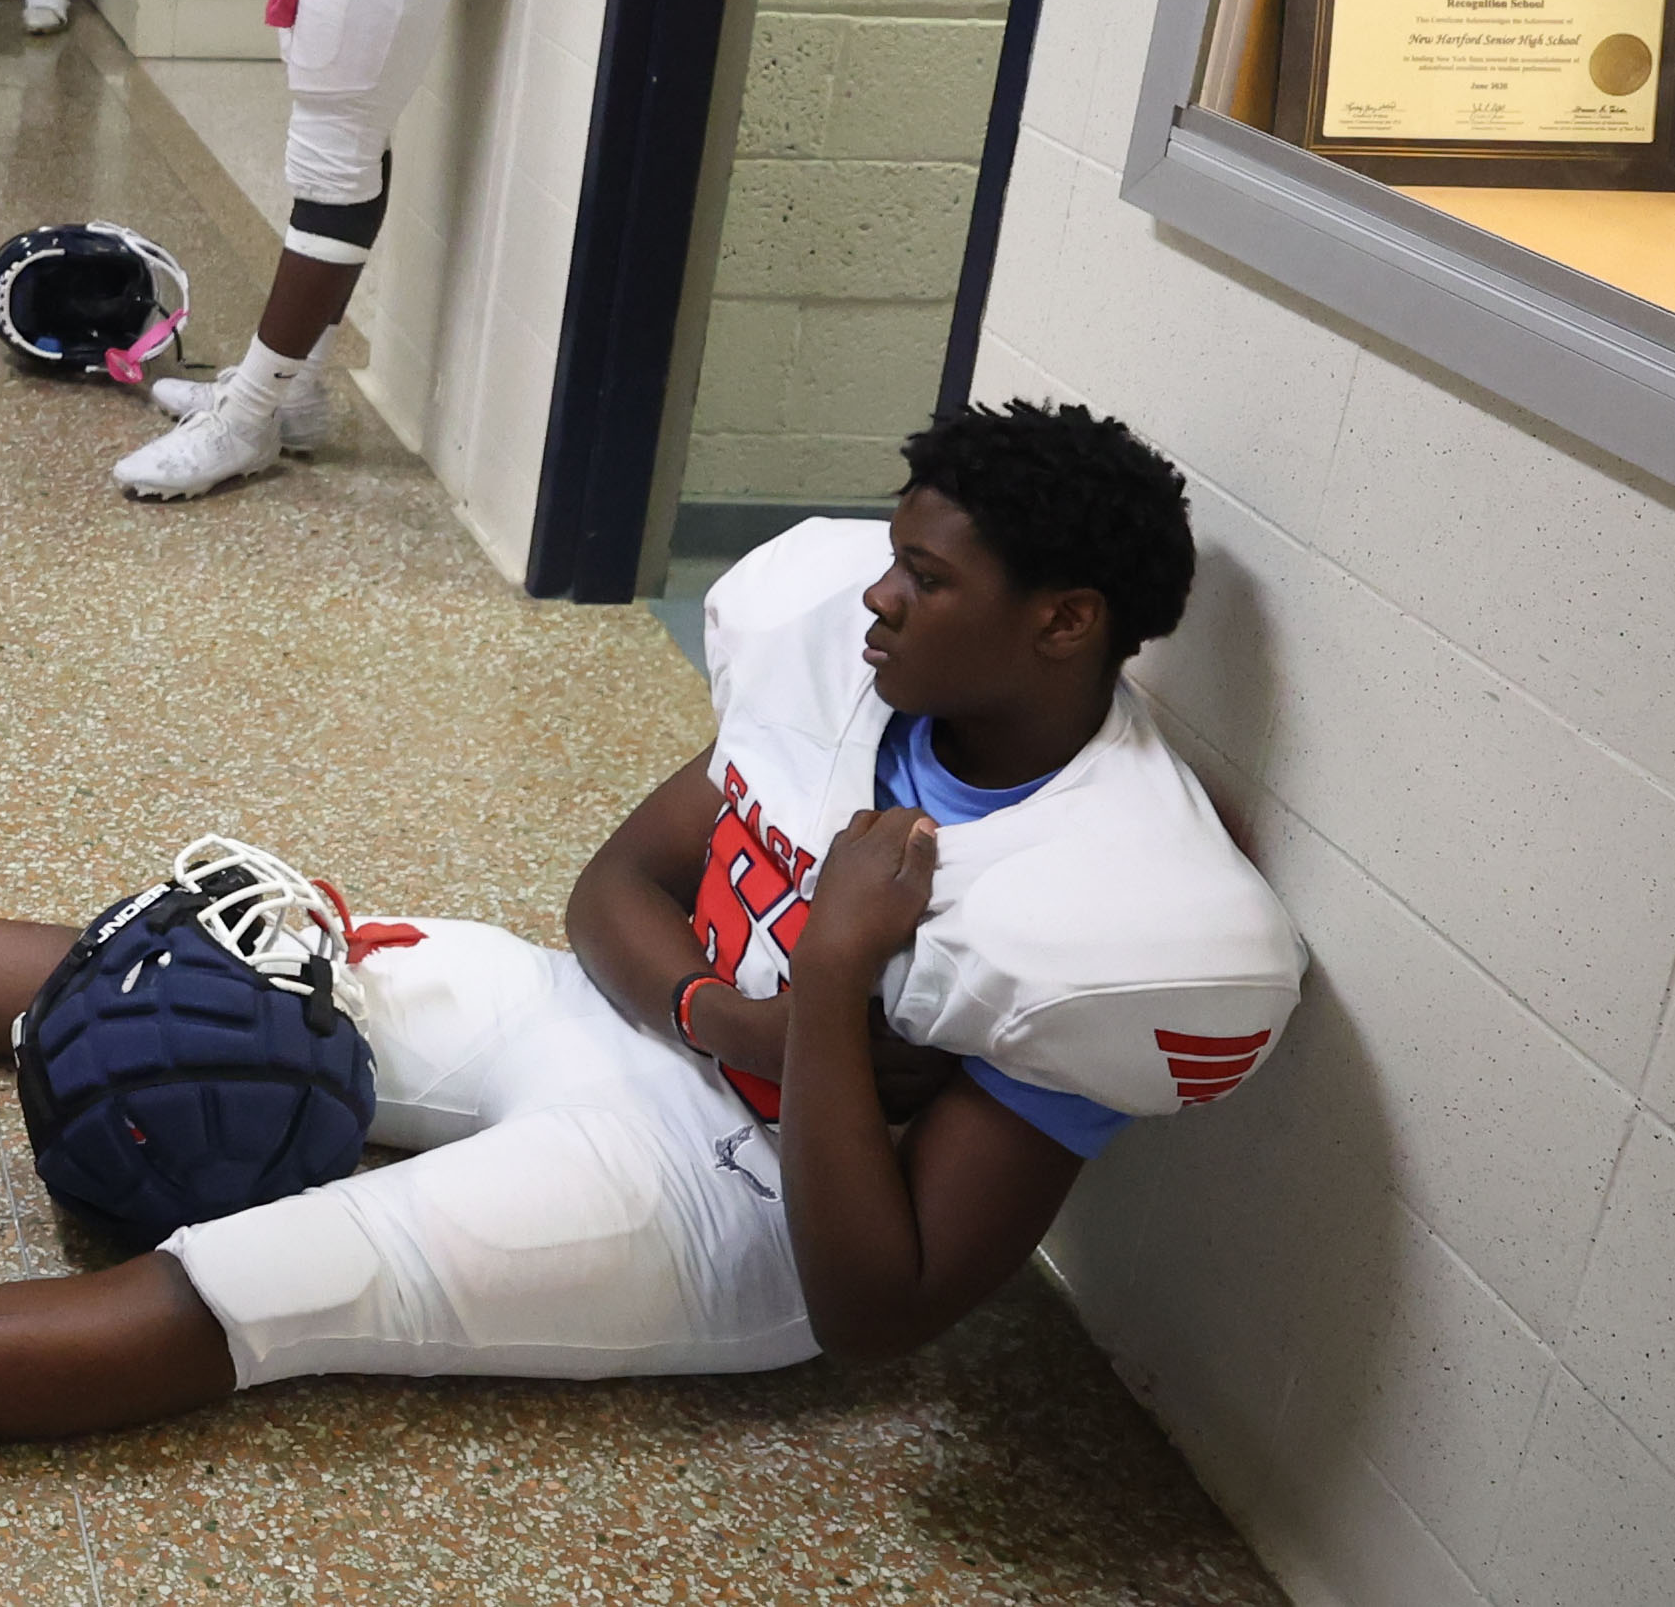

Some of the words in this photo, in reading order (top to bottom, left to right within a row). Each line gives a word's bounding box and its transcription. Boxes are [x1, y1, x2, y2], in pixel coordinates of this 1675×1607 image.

[1408, 34, 1434, 46] New
[1436, 33, 1482, 49] Hartford
[1483, 34, 1516, 46] Senior
[1517, 34, 1547, 49] High
[1548, 33, 1580, 47] School
